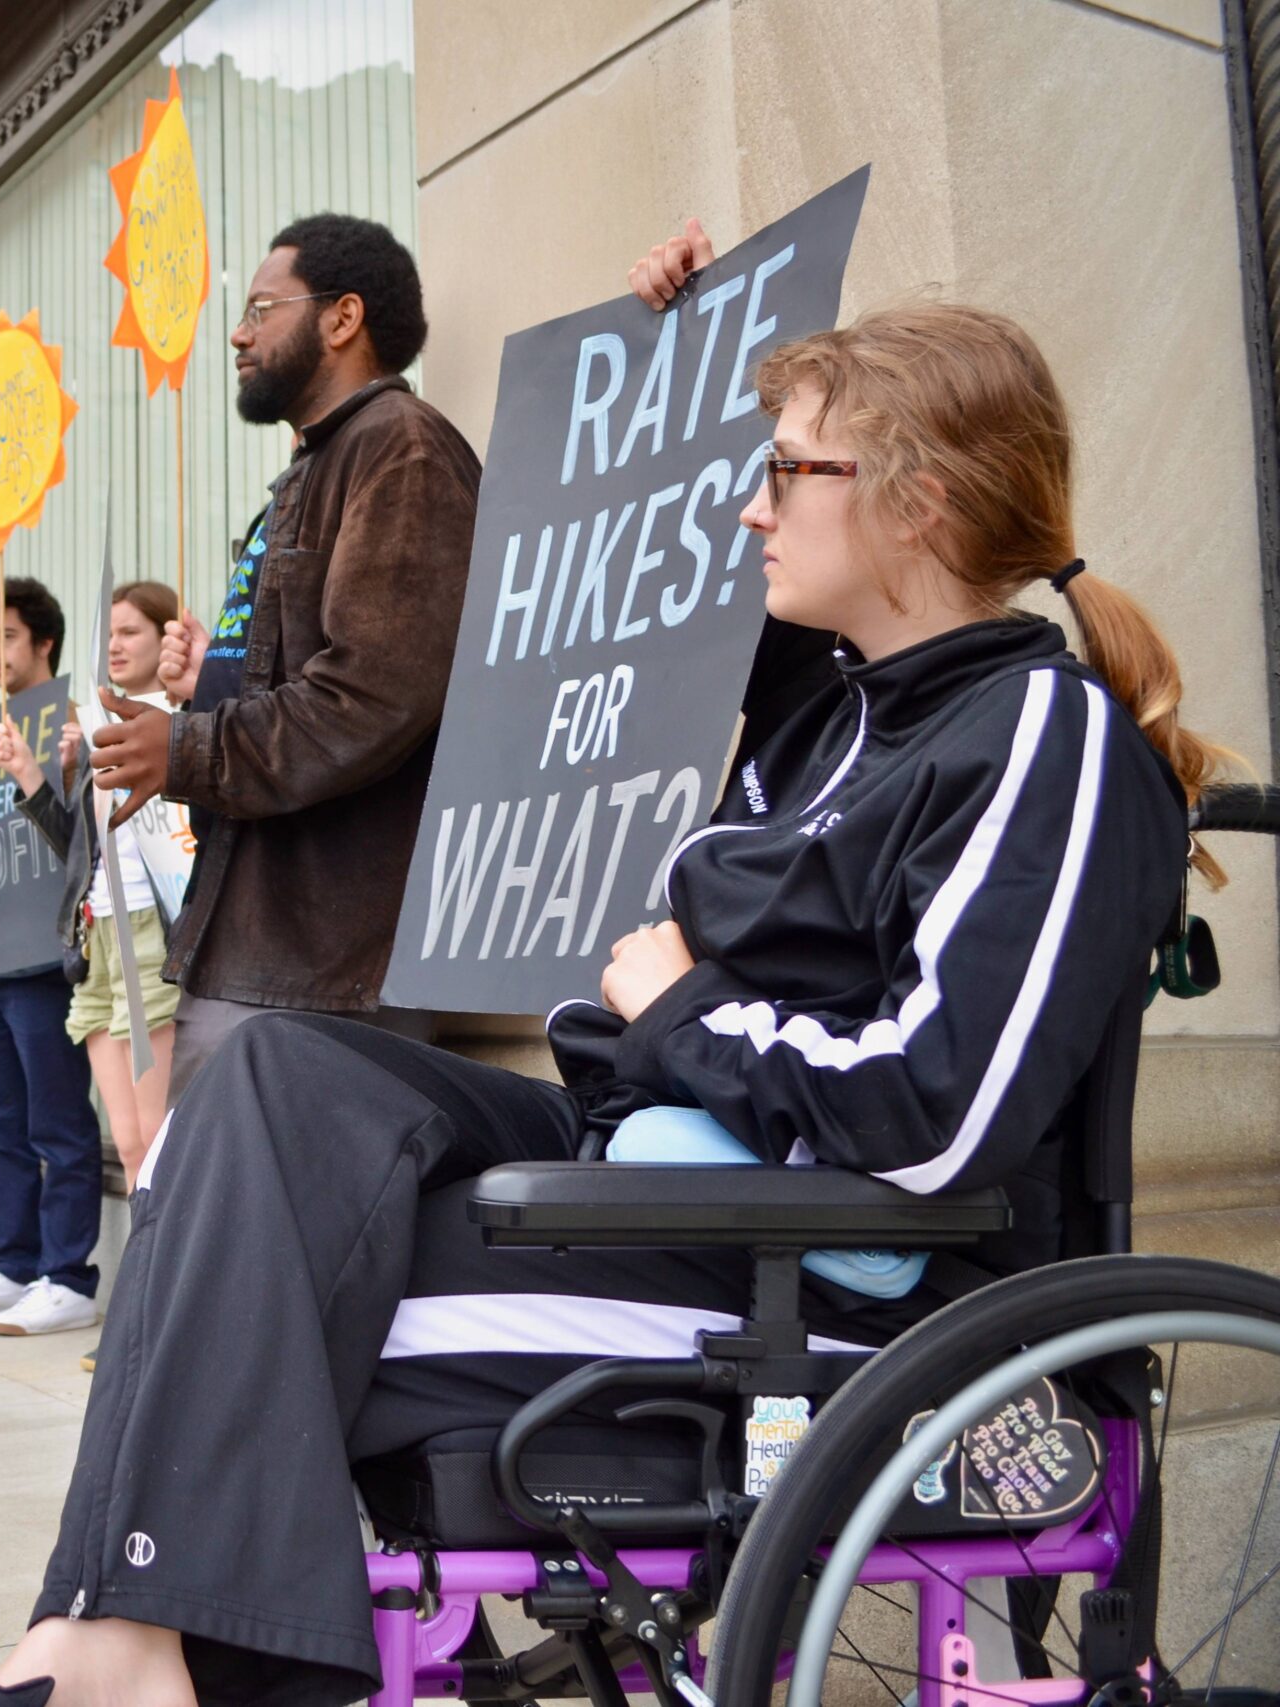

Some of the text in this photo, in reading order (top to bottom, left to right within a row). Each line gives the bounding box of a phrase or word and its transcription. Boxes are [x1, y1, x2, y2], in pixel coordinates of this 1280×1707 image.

[560, 242, 795, 486] RATE
[485, 440, 775, 667] HIKES?
[538, 664, 636, 771] FOR
[420, 766, 702, 961] WHAT?
[764, 1461, 776, 1476] is
[971, 1424, 999, 1458] Pro
[996, 1456, 1044, 1510] Choice
[988, 1415, 1054, 1494] Pro Trans
[999, 1402, 1070, 1482] Pro Weed
[1019, 1396, 1074, 1462] Pro Gay
[970, 1446, 995, 1480] Pro
[993, 1476, 1025, 1514] Hoe
